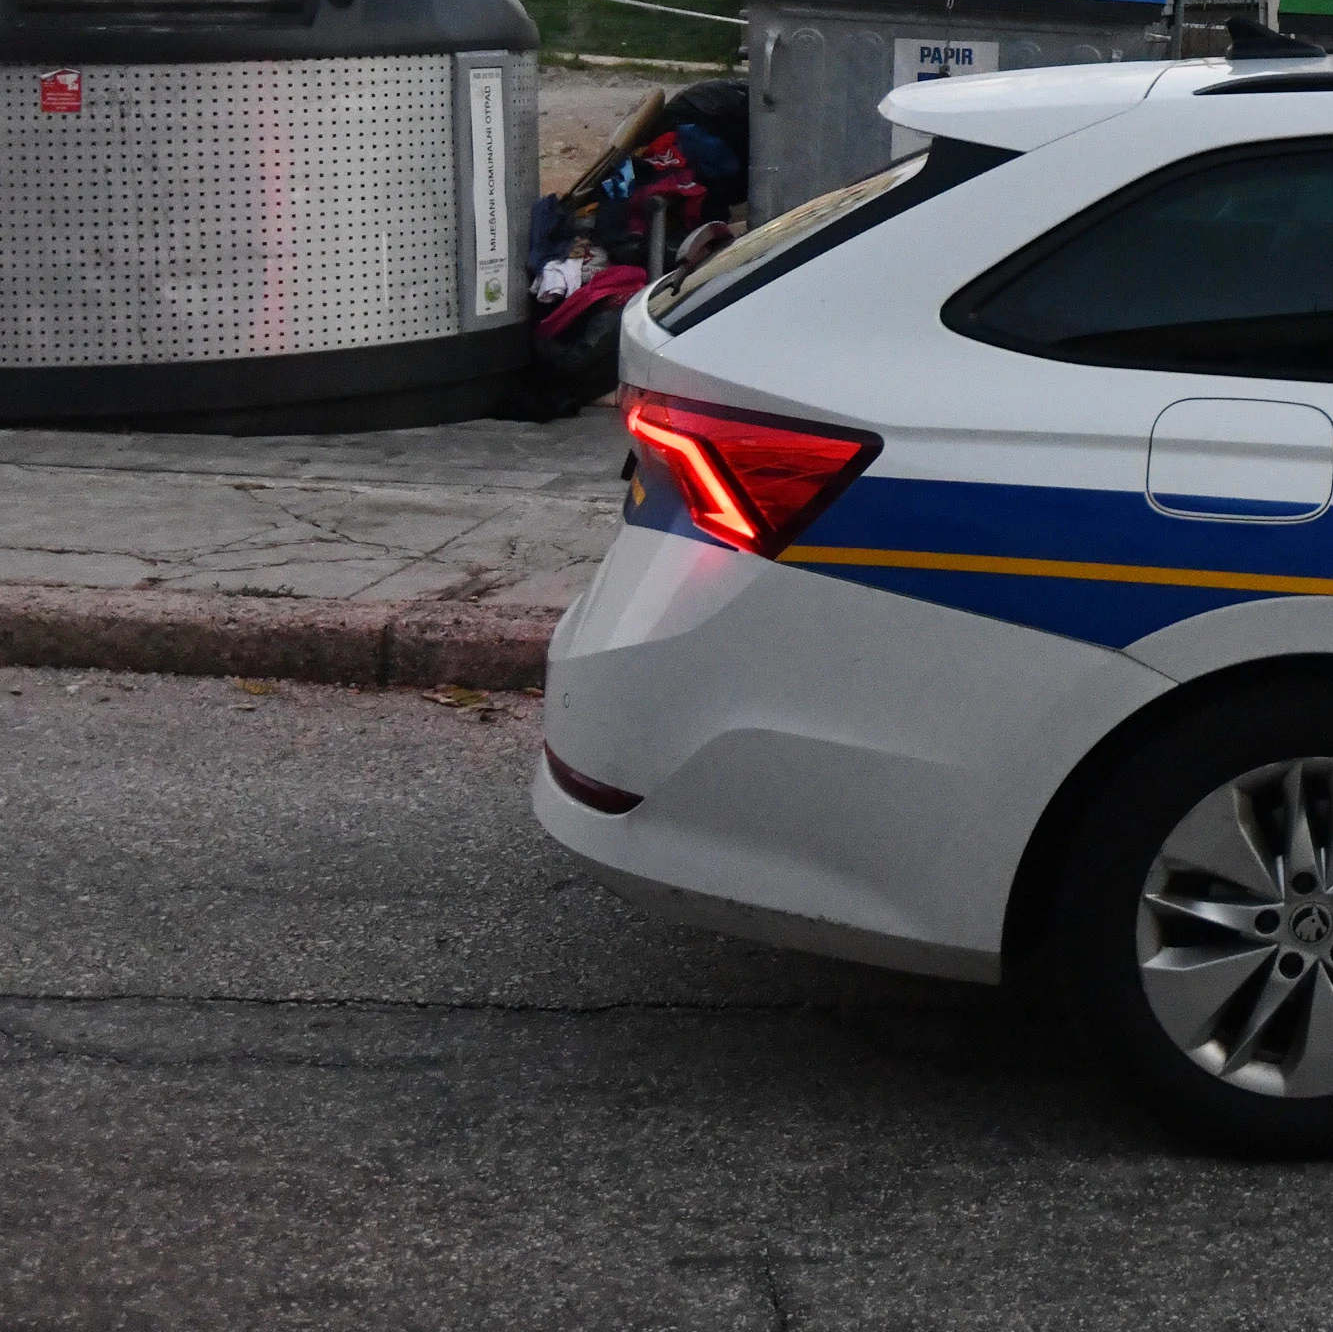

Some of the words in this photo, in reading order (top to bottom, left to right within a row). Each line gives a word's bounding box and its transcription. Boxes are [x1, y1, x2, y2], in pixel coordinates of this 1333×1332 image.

[920, 46, 973, 65] PAPIR
[483, 85, 492, 124] OTPAD
[486, 127, 496, 196] KOMUNALNI
[487, 198, 497, 252] MIJEŠANI
